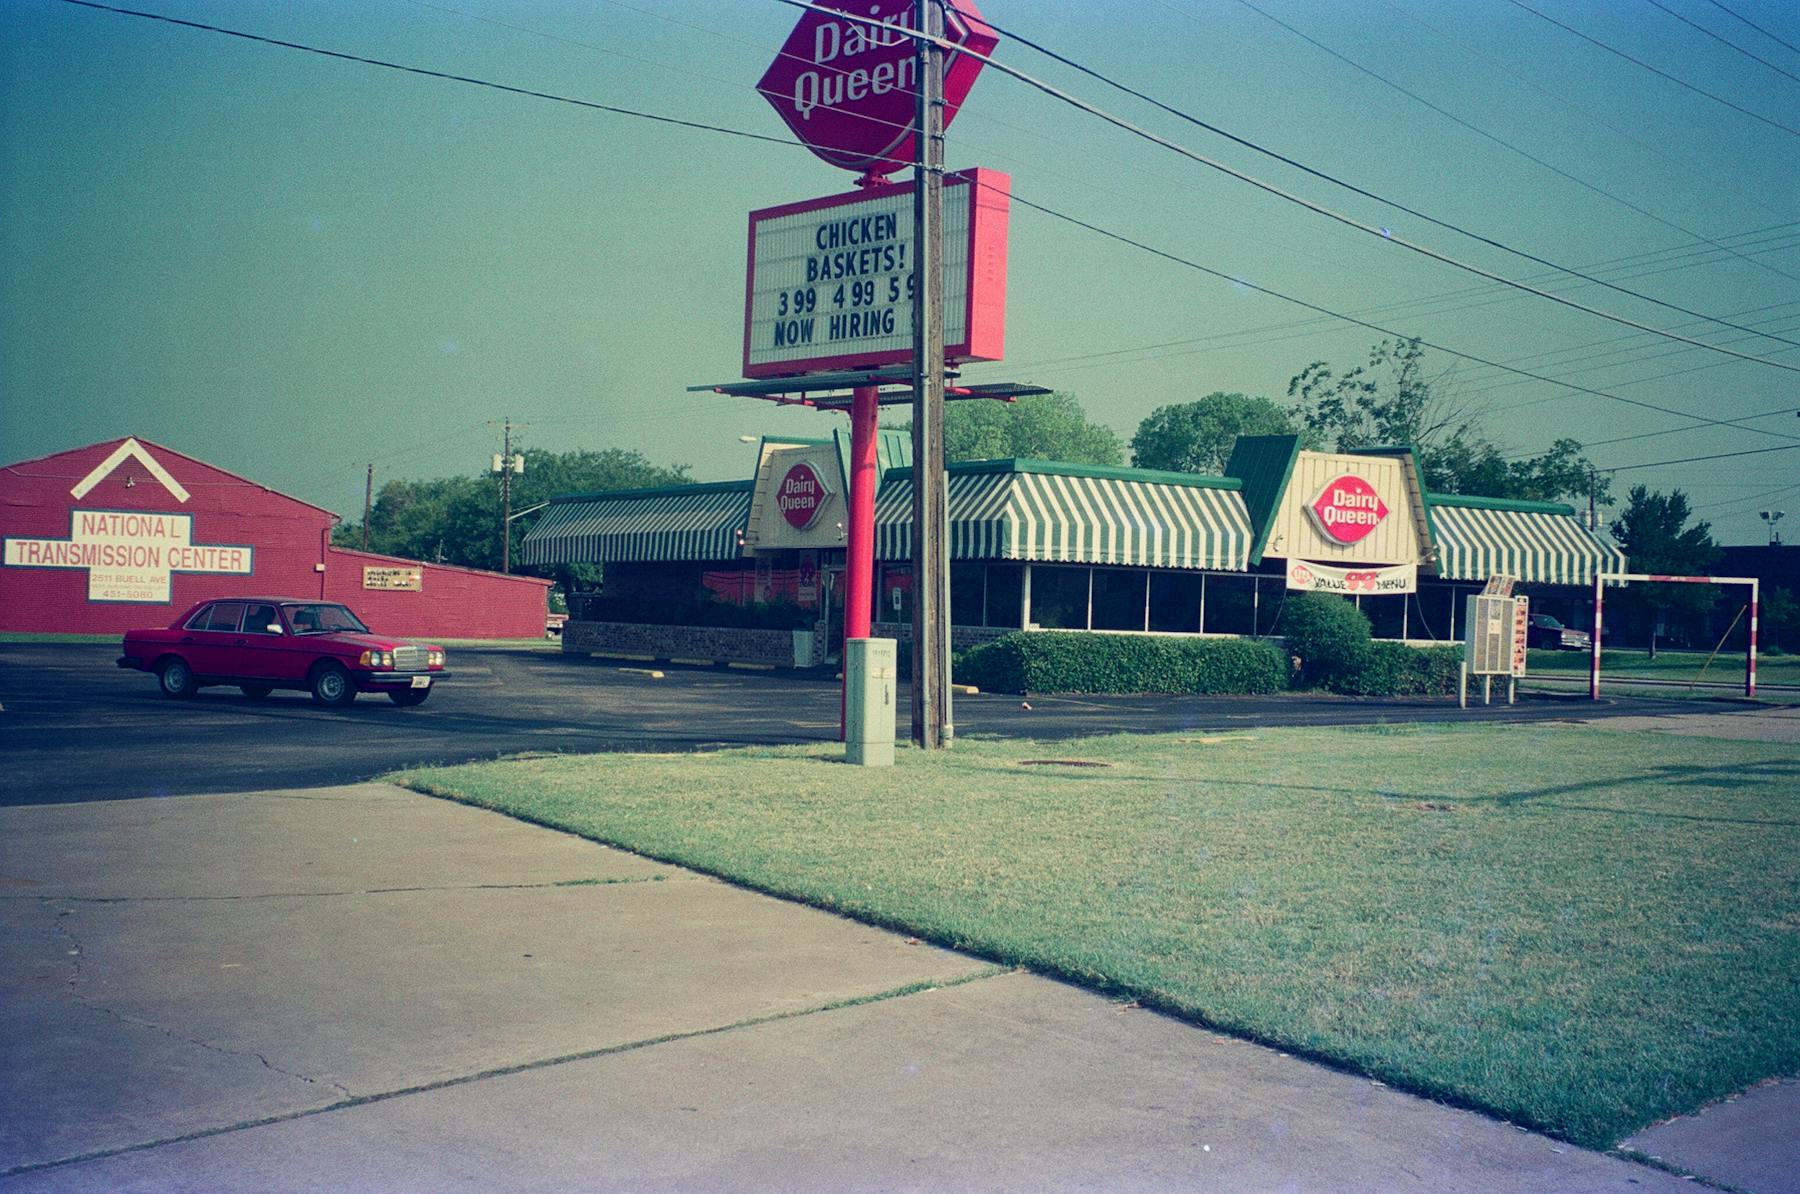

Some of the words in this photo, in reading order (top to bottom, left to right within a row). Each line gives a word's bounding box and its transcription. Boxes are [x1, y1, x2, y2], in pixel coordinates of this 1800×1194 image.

[794, 56, 917, 120] Queen
[816, 212, 897, 250] CHICKEN
[807, 244, 906, 282] BASKETS!
[774, 318, 815, 346] NOW
[829, 308, 895, 341] HIRING
[785, 475, 815, 495] Dairy
[781, 495, 815, 513] Queen
[1333, 487, 1379, 511] Dairy
[82, 514, 182, 538] NATIONAL
[1324, 506, 1379, 526] Queen
[16, 541, 161, 568] TRANSMISSION
[167, 547, 242, 570] CENTER
[1313, 576, 1347, 590] VALUE
[1376, 578, 1406, 590] MENU
